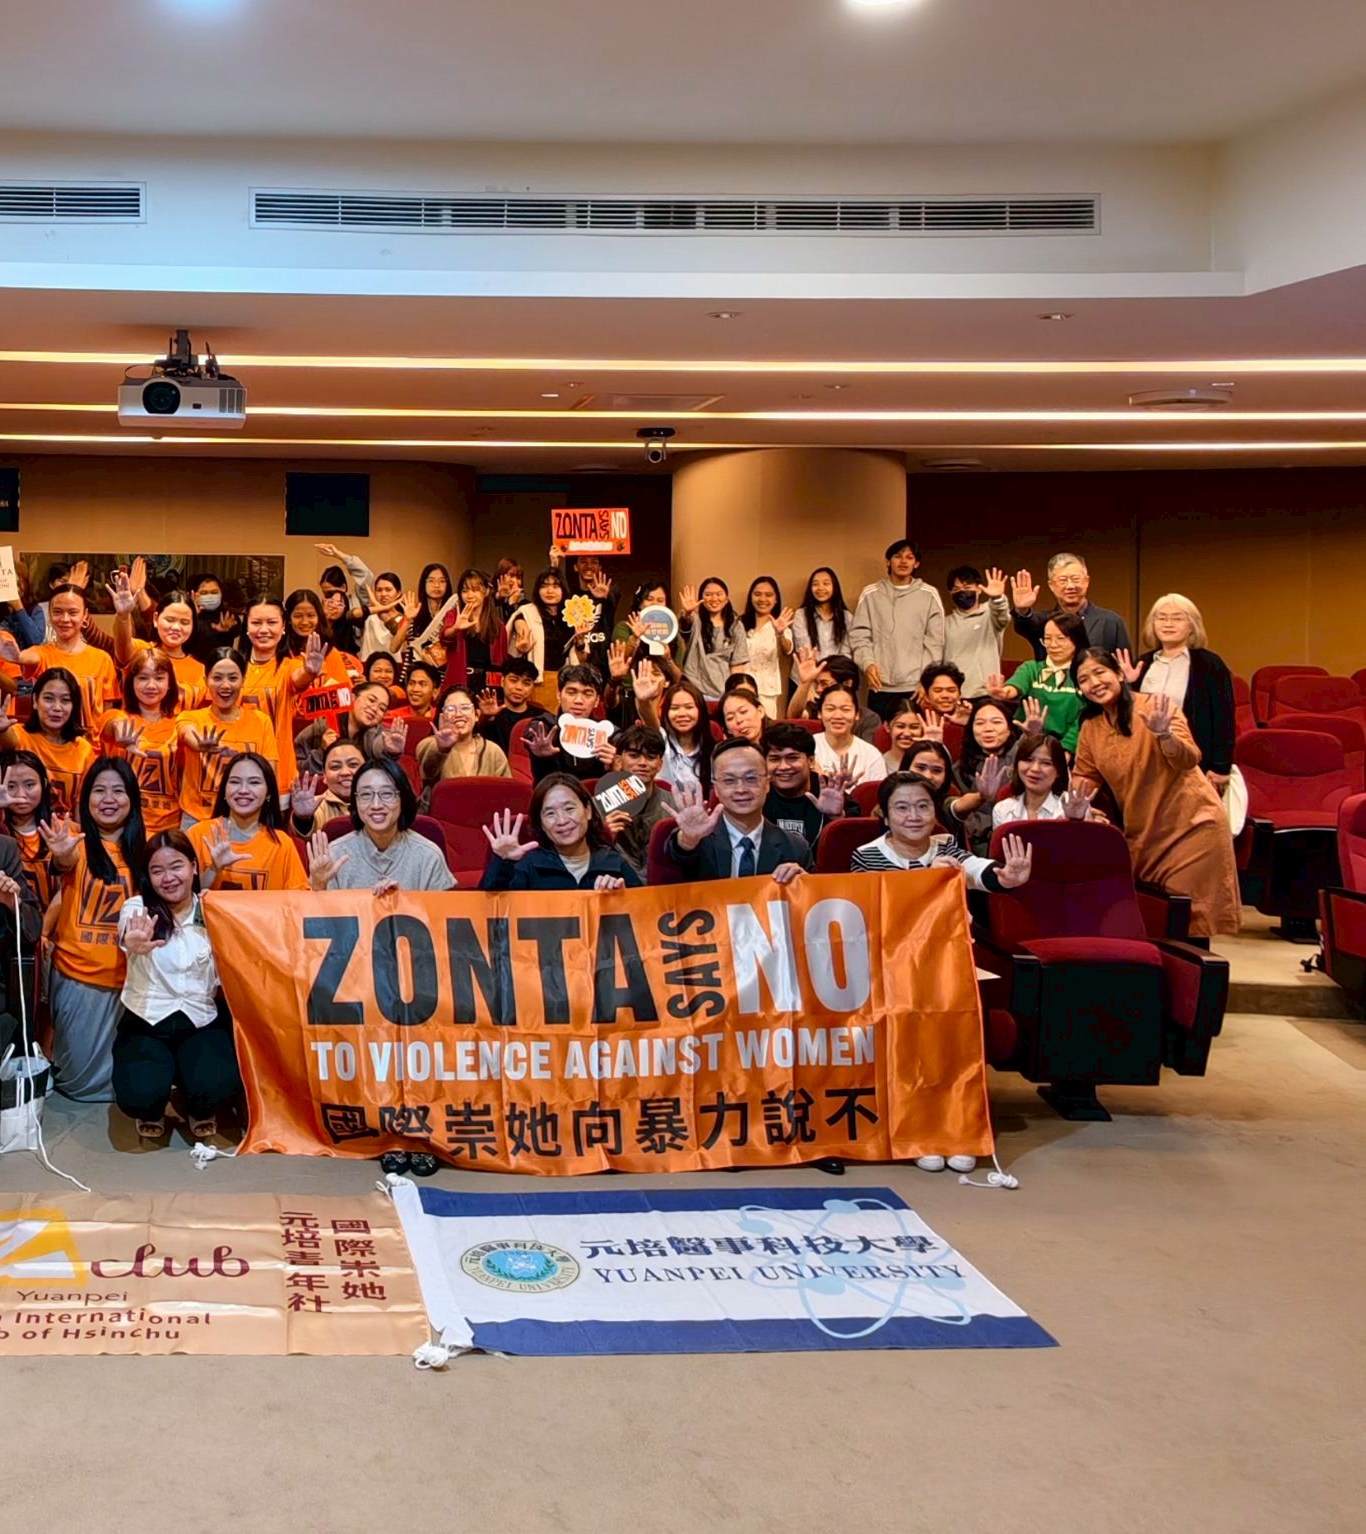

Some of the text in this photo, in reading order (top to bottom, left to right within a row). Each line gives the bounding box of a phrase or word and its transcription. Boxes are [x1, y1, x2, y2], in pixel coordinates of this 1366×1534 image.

[555, 510, 627, 540] ZONTA SAYS NO
[562, 724, 587, 746] ZONTA
[586, 727, 596, 749] SAYS
[595, 784, 631, 813] ZONTA
[626, 774, 647, 797] NO
[303, 898, 871, 1026] ZONTA SAYS NO
[310, 1025, 875, 1083] TO VIOLENCE AGAINST WOMEN
[321, 1087, 879, 1161] 國際崇她向暴力說不
[90, 1242, 251, 1279] club
[579, 1234, 941, 1260] 元培醫事科技大學
[593, 1262, 968, 1285] YUANPEI UNIVERSITY
[16, 1290, 129, 1307] Yuanpei
[15, 1307, 212, 1326] International
[22, 1326, 49, 1340] of
[62, 1326, 181, 1340] Hsinchu
